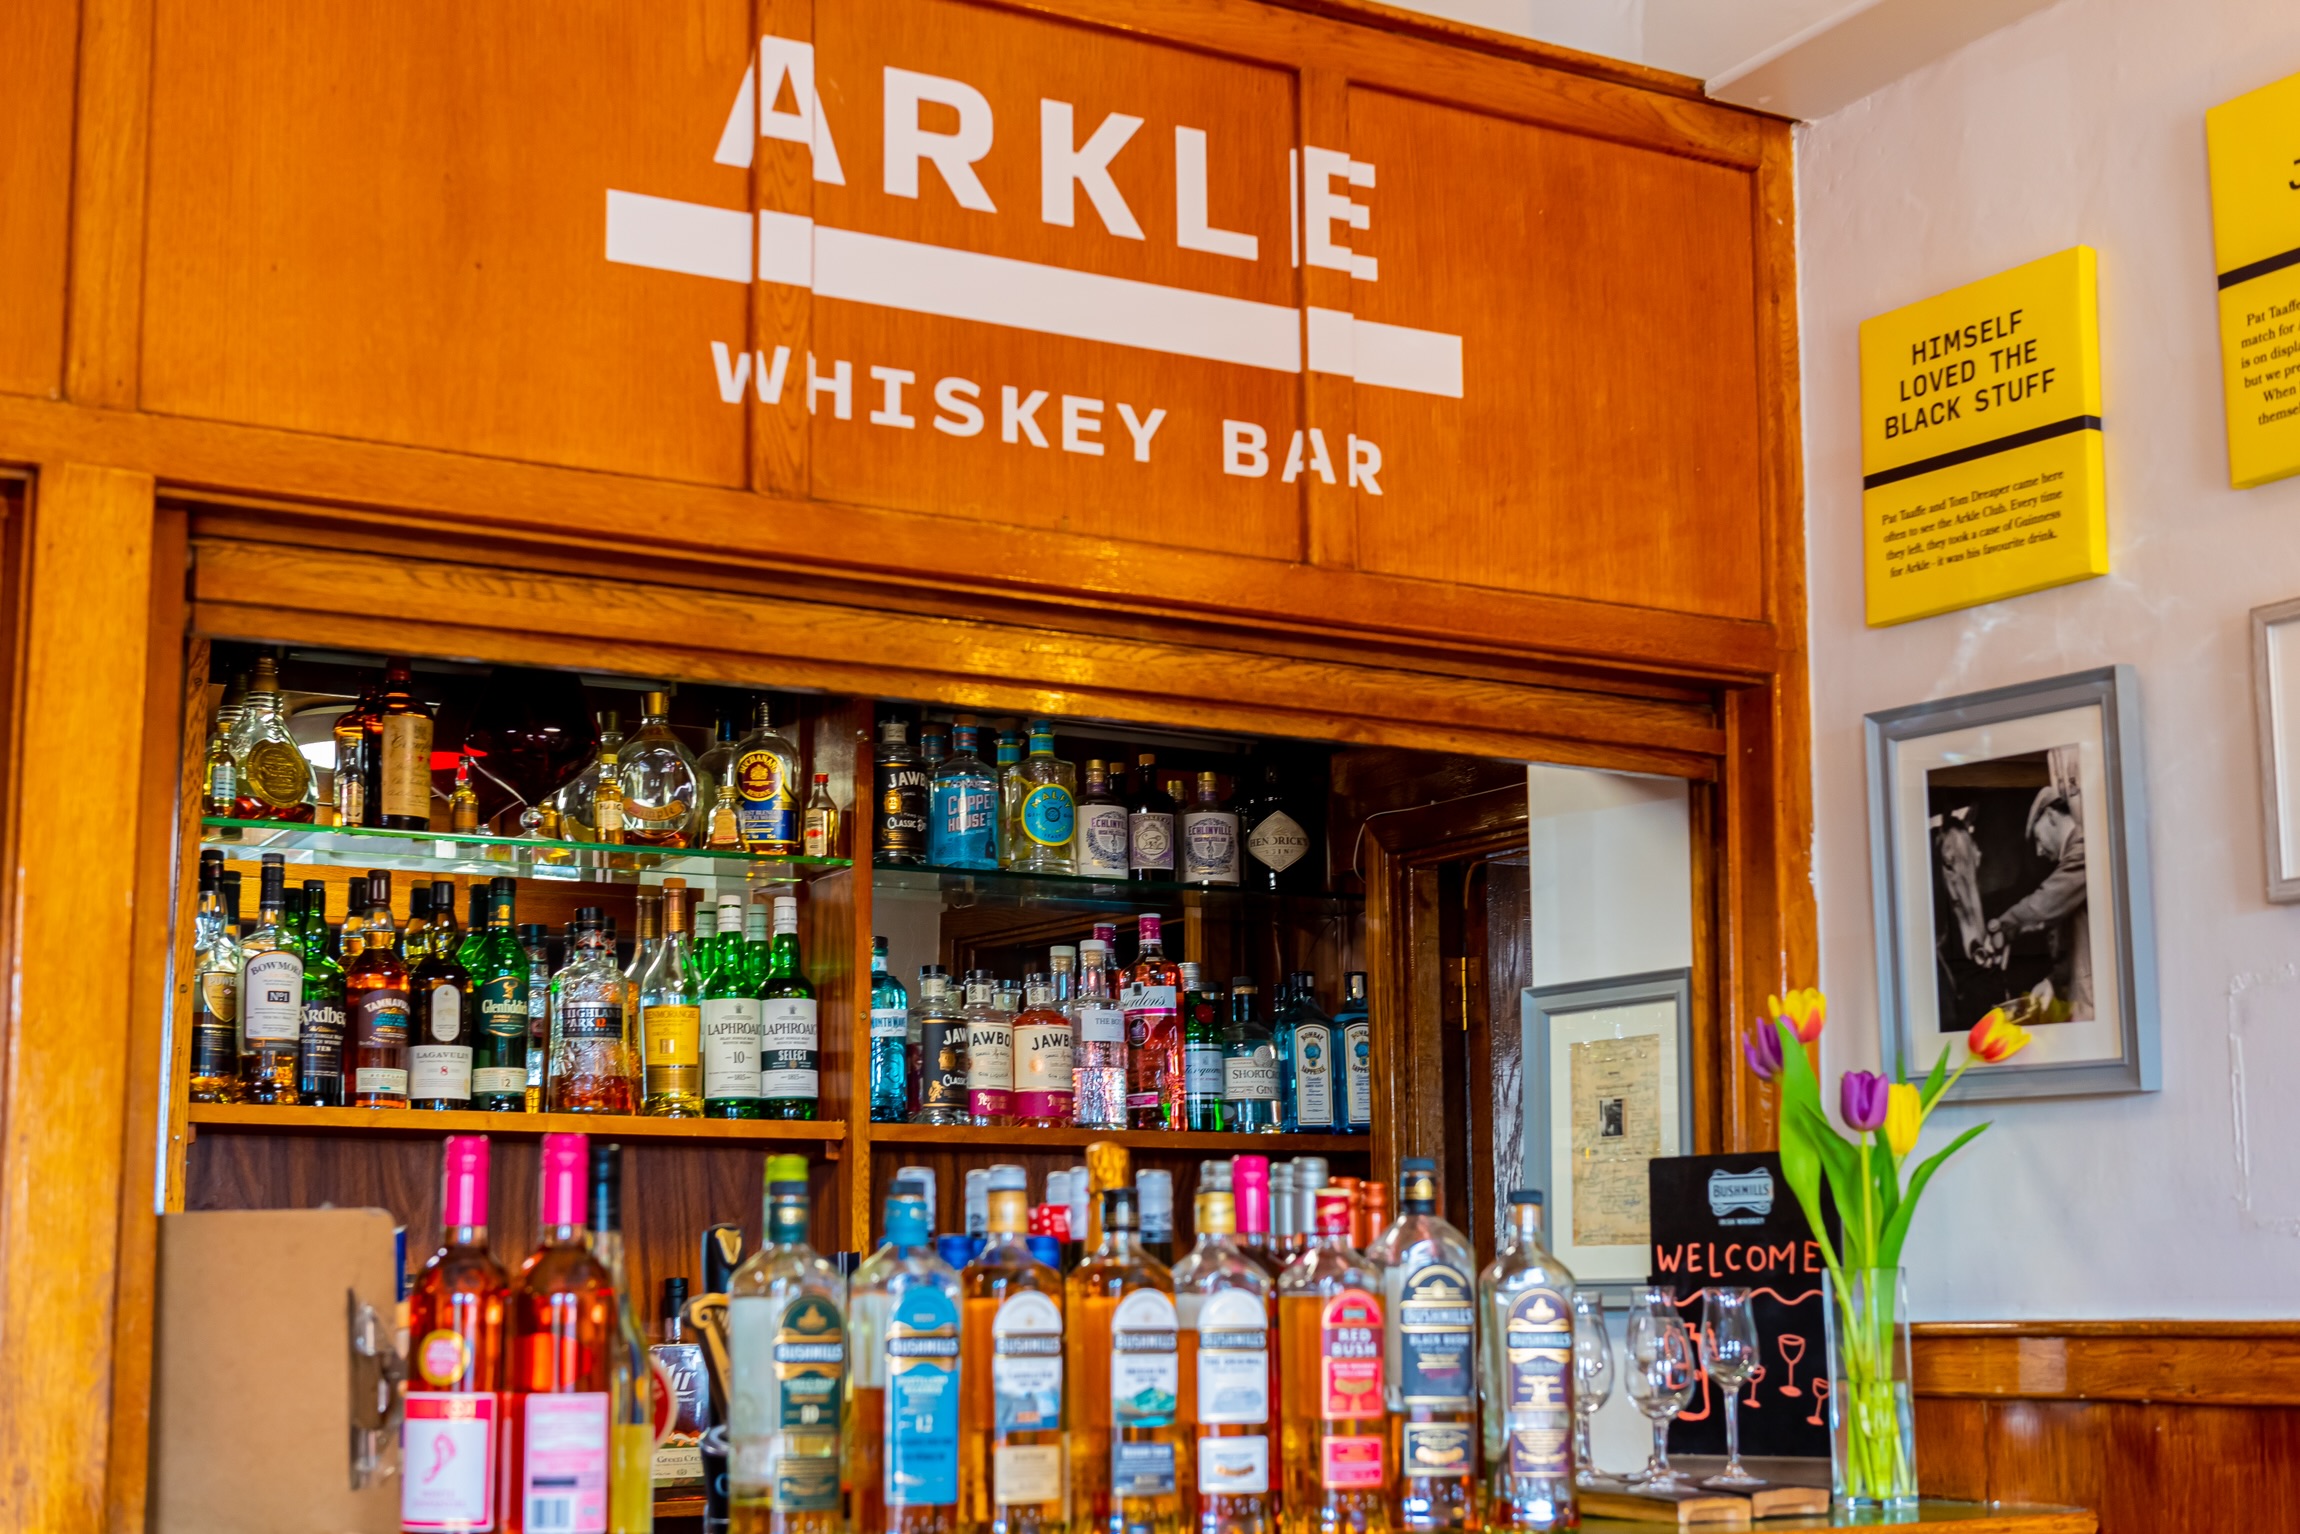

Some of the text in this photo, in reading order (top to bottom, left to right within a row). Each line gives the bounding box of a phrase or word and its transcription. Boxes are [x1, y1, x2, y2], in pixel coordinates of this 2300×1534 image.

[714, 35, 1378, 282] ARKLE
[2246, 312, 2265, 326] Pat
[1911, 309, 2023, 366] HIMSELF
[2241, 328, 2276, 349] match
[2279, 323, 2295, 337] for
[1899, 339, 2038, 402] LOVED THE
[2241, 357, 2251, 369] is
[2253, 353, 2267, 365] on
[2244, 375, 2262, 389] but
[2265, 370, 2281, 381] we
[2263, 385, 2296, 403] When
[1884, 368, 2056, 440] BLACK STUFF
[711, 341, 1383, 496] WHISKEY BAR
[1882, 514, 1897, 526] Pat
[1929, 499, 1946, 513] and
[1949, 496, 1968, 510] Tom
[1971, 484, 2011, 502] Dreaper
[2012, 477, 2039, 491] came
[2041, 470, 2064, 484] here
[1883, 530, 1906, 544] often
[1908, 527, 1918, 536] to
[1919, 523, 1935, 534] see
[1937, 516, 1952, 530] the
[1954, 510, 1980, 525] Arkle
[2010, 495, 2038, 512] Every
[2040, 489, 2063, 504] time
[1886, 548, 1905, 561] they
[1926, 537, 1946, 552] they
[1948, 531, 1969, 546] took
[1979, 526, 2001, 538] case
[2002, 518, 2013, 532] of
[2014, 510, 2061, 529] Guinness
[1890, 566, 1903, 579] for
[1905, 559, 1930, 574] Arkle
[1937, 555, 1944, 566] it
[1946, 552, 1964, 565] was
[1966, 546, 1980, 560] his
[1983, 537, 2025, 556] favourite
[888, 771, 928, 790] JAWB
[948, 794, 996, 815] COPPER
[948, 813, 987, 832] HOUSE
[1189, 826, 1232, 836] ECHLINVILLE
[563, 1009, 622, 1018] HIGHLAND
[564, 1018, 607, 1028] PARK 12
[733, 1051, 745, 1064] 10
[778, 1050, 807, 1062] SELECT
[440, 1066, 448, 1076] 8
[1256, 1085, 1273, 1094] GIN
[1713, 1183, 1769, 1198] BUSHMILLS
[1656, 1240, 1822, 1278] WELCOME
[1338, 1328, 1371, 1342] RED
[1331, 1343, 1377, 1357] BUSH
